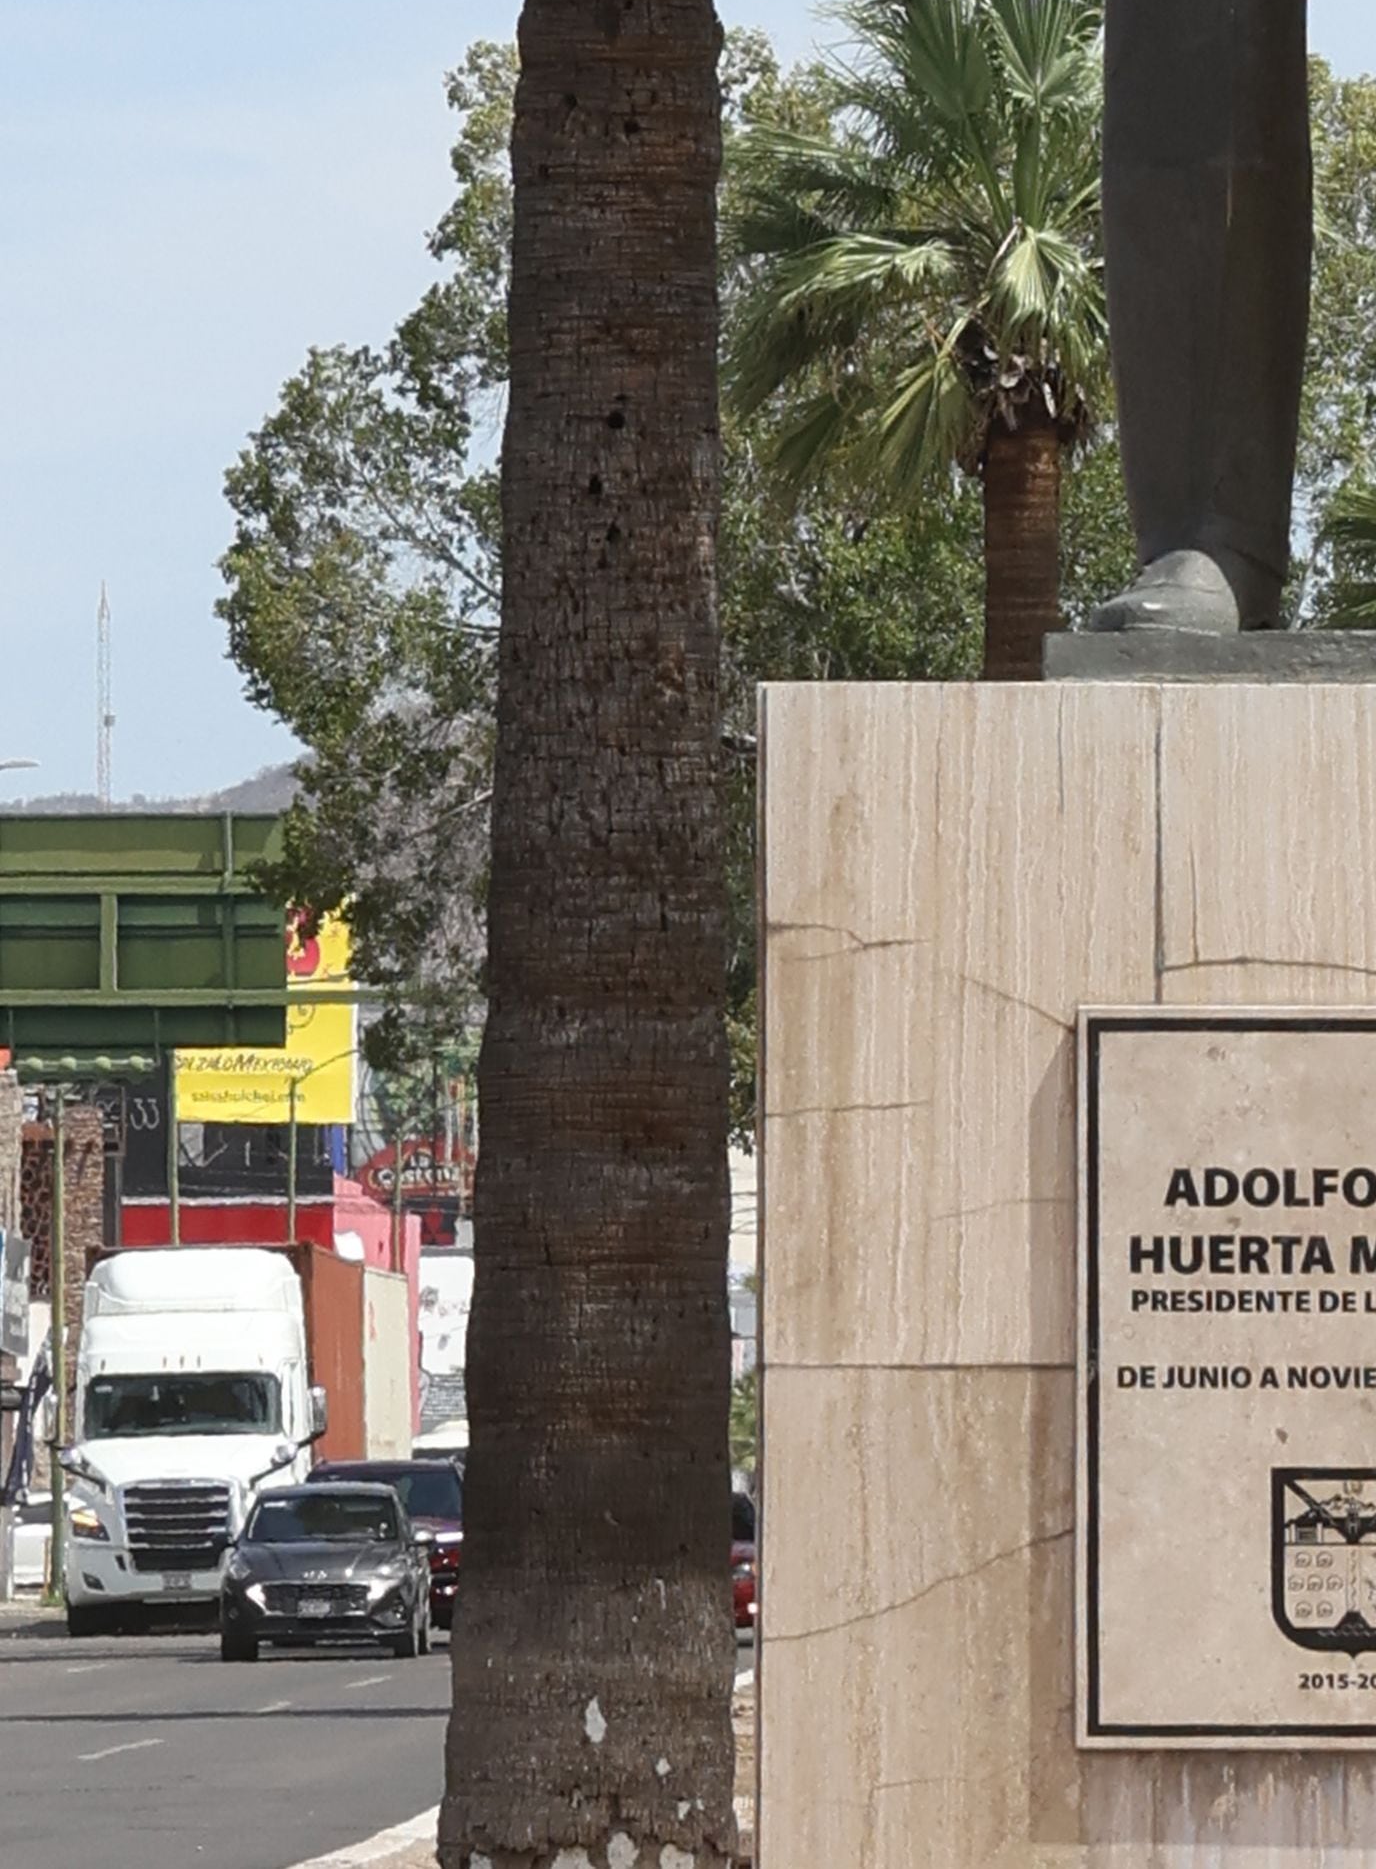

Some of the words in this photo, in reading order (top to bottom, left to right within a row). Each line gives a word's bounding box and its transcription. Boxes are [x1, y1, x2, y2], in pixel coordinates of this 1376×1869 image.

[1129, 1234, 1335, 1275] HUERTA
[1131, 1289, 1311, 1313] PRESIDENTE
[1318, 1290, 1357, 1313] DE
[1117, 1366, 1156, 1389] DE
[1162, 1366, 1252, 1389] JUNIO
[1259, 1366, 1279, 1389] A
